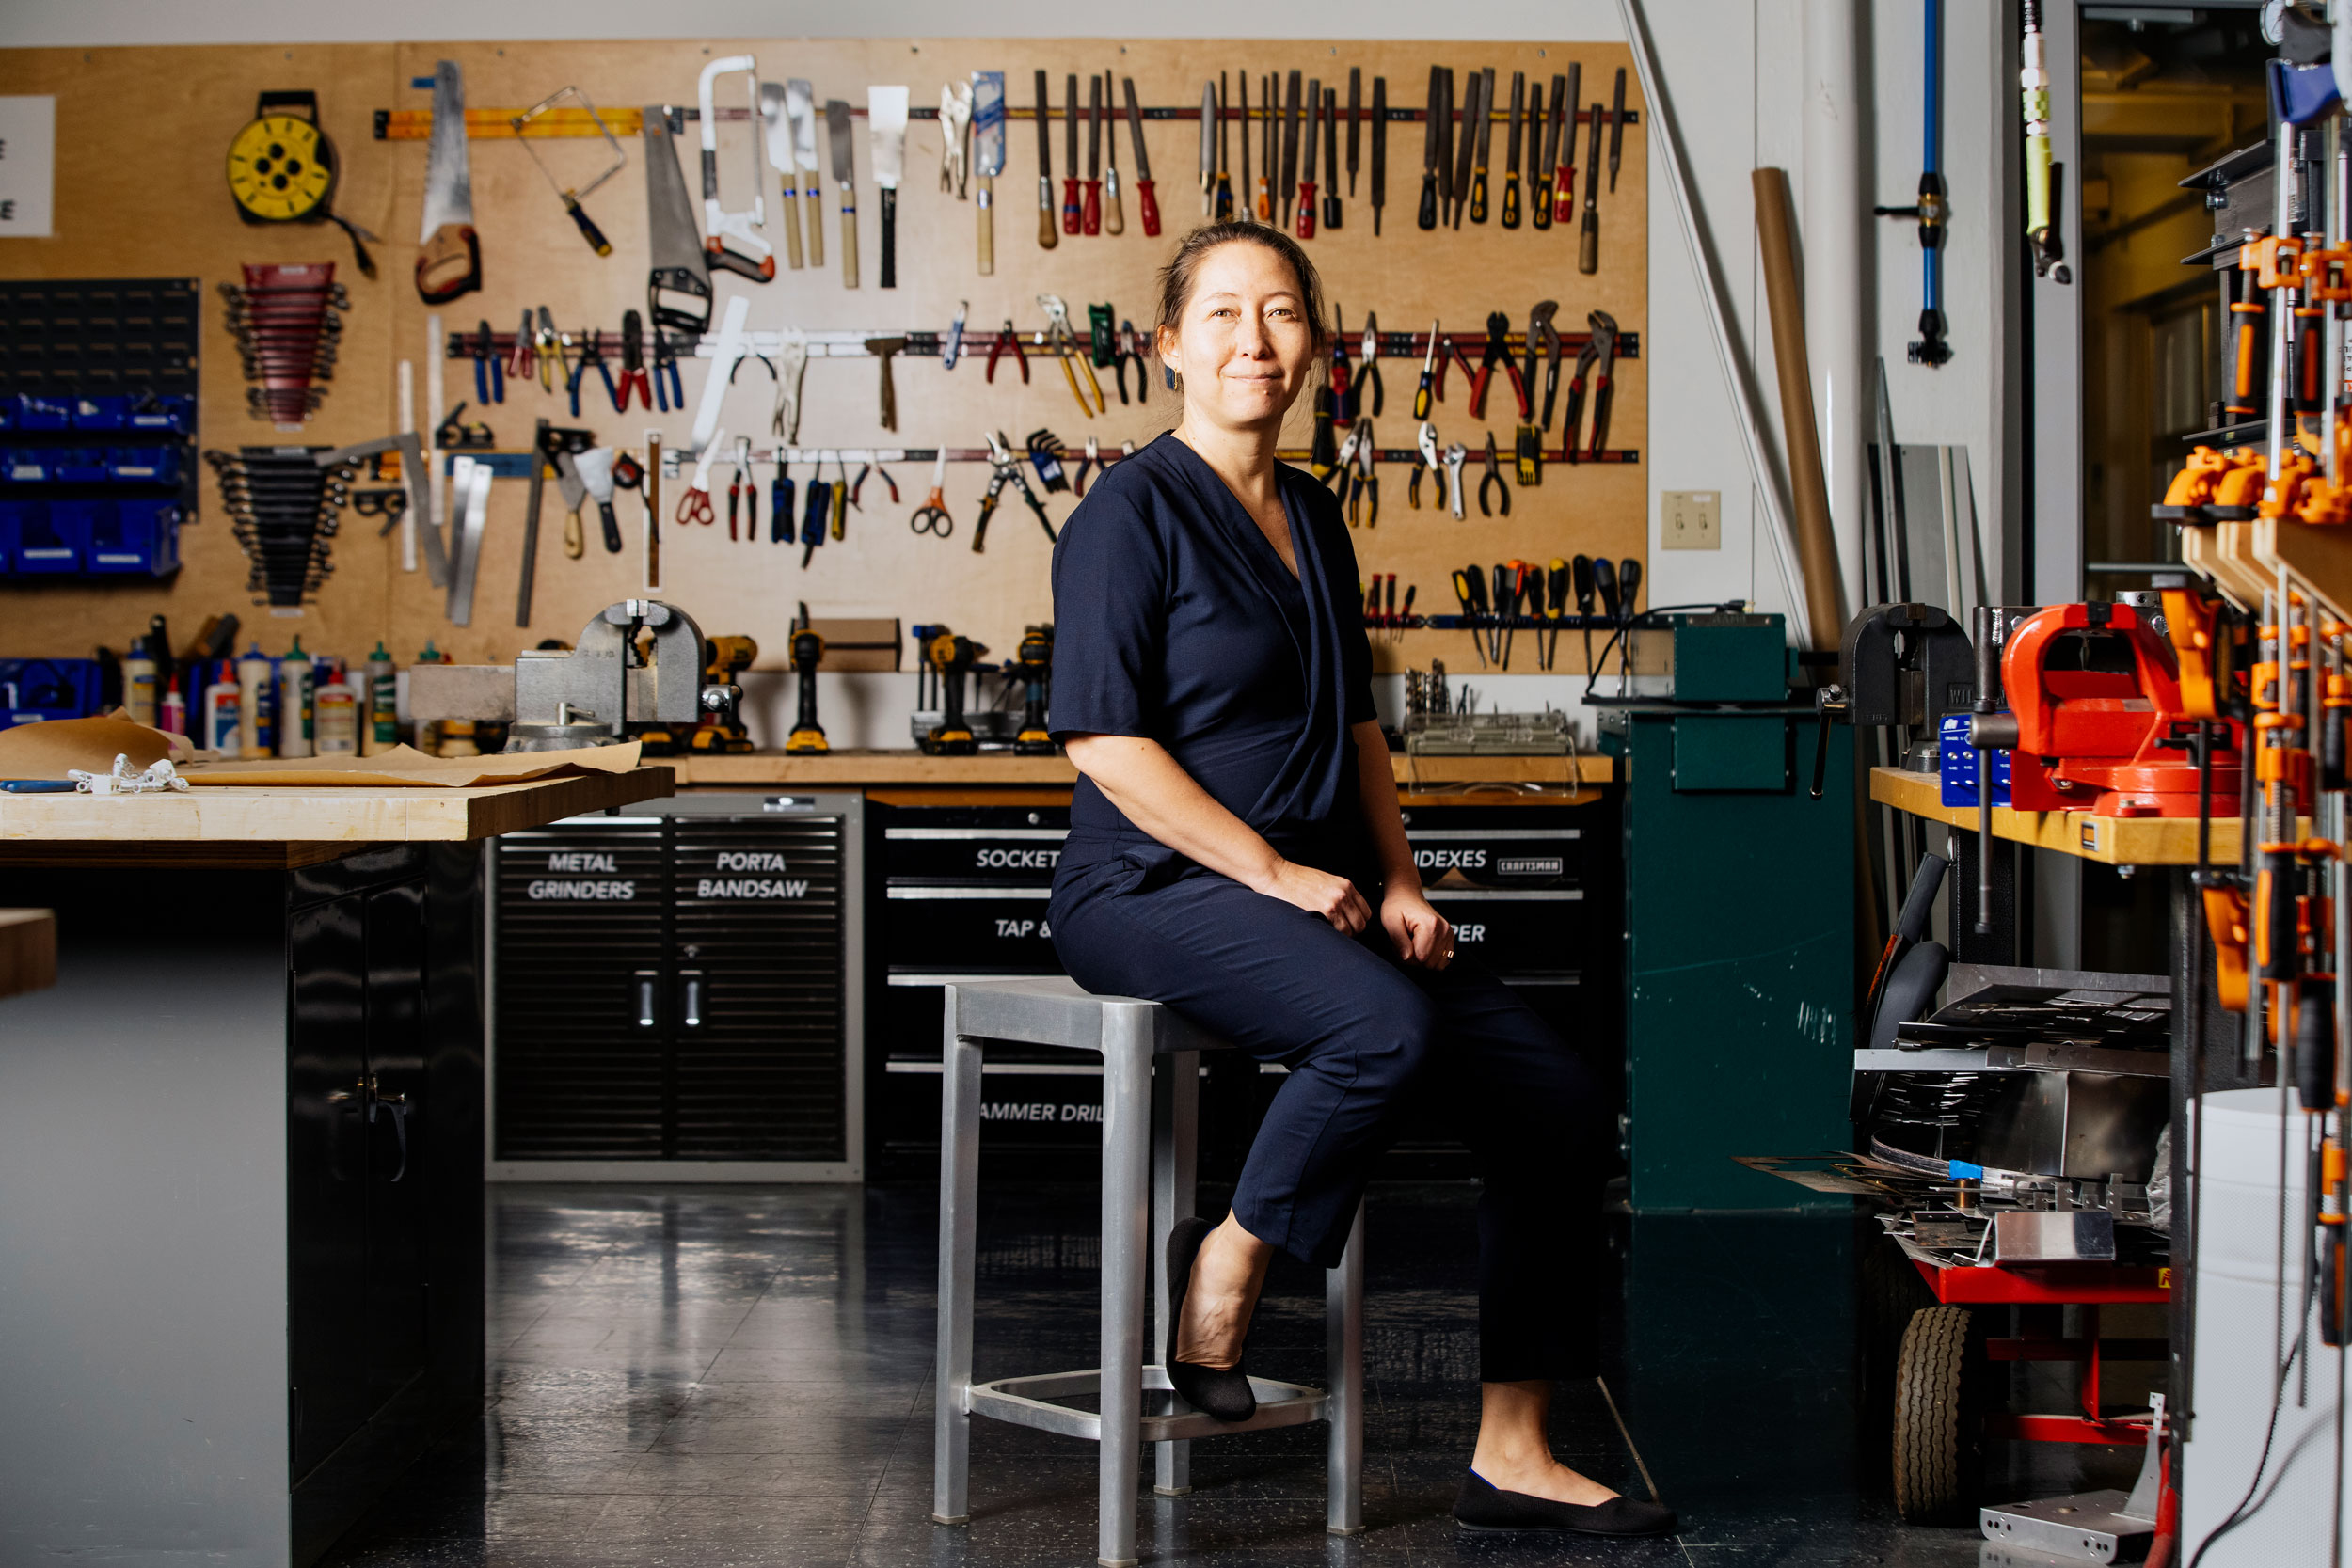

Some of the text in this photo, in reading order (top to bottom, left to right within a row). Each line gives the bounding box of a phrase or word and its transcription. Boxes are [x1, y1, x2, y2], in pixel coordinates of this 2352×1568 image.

[548, 853, 618, 873] METAL
[716, 852, 786, 872] PORTA
[1501, 861, 1559, 872] CRAFTSMAN
[528, 880, 635, 900] GRINDERS
[697, 879, 808, 898] BANDSAW
[995, 919, 1051, 938] TAP &
[980, 1102, 1103, 1122] AMMER DRIL
